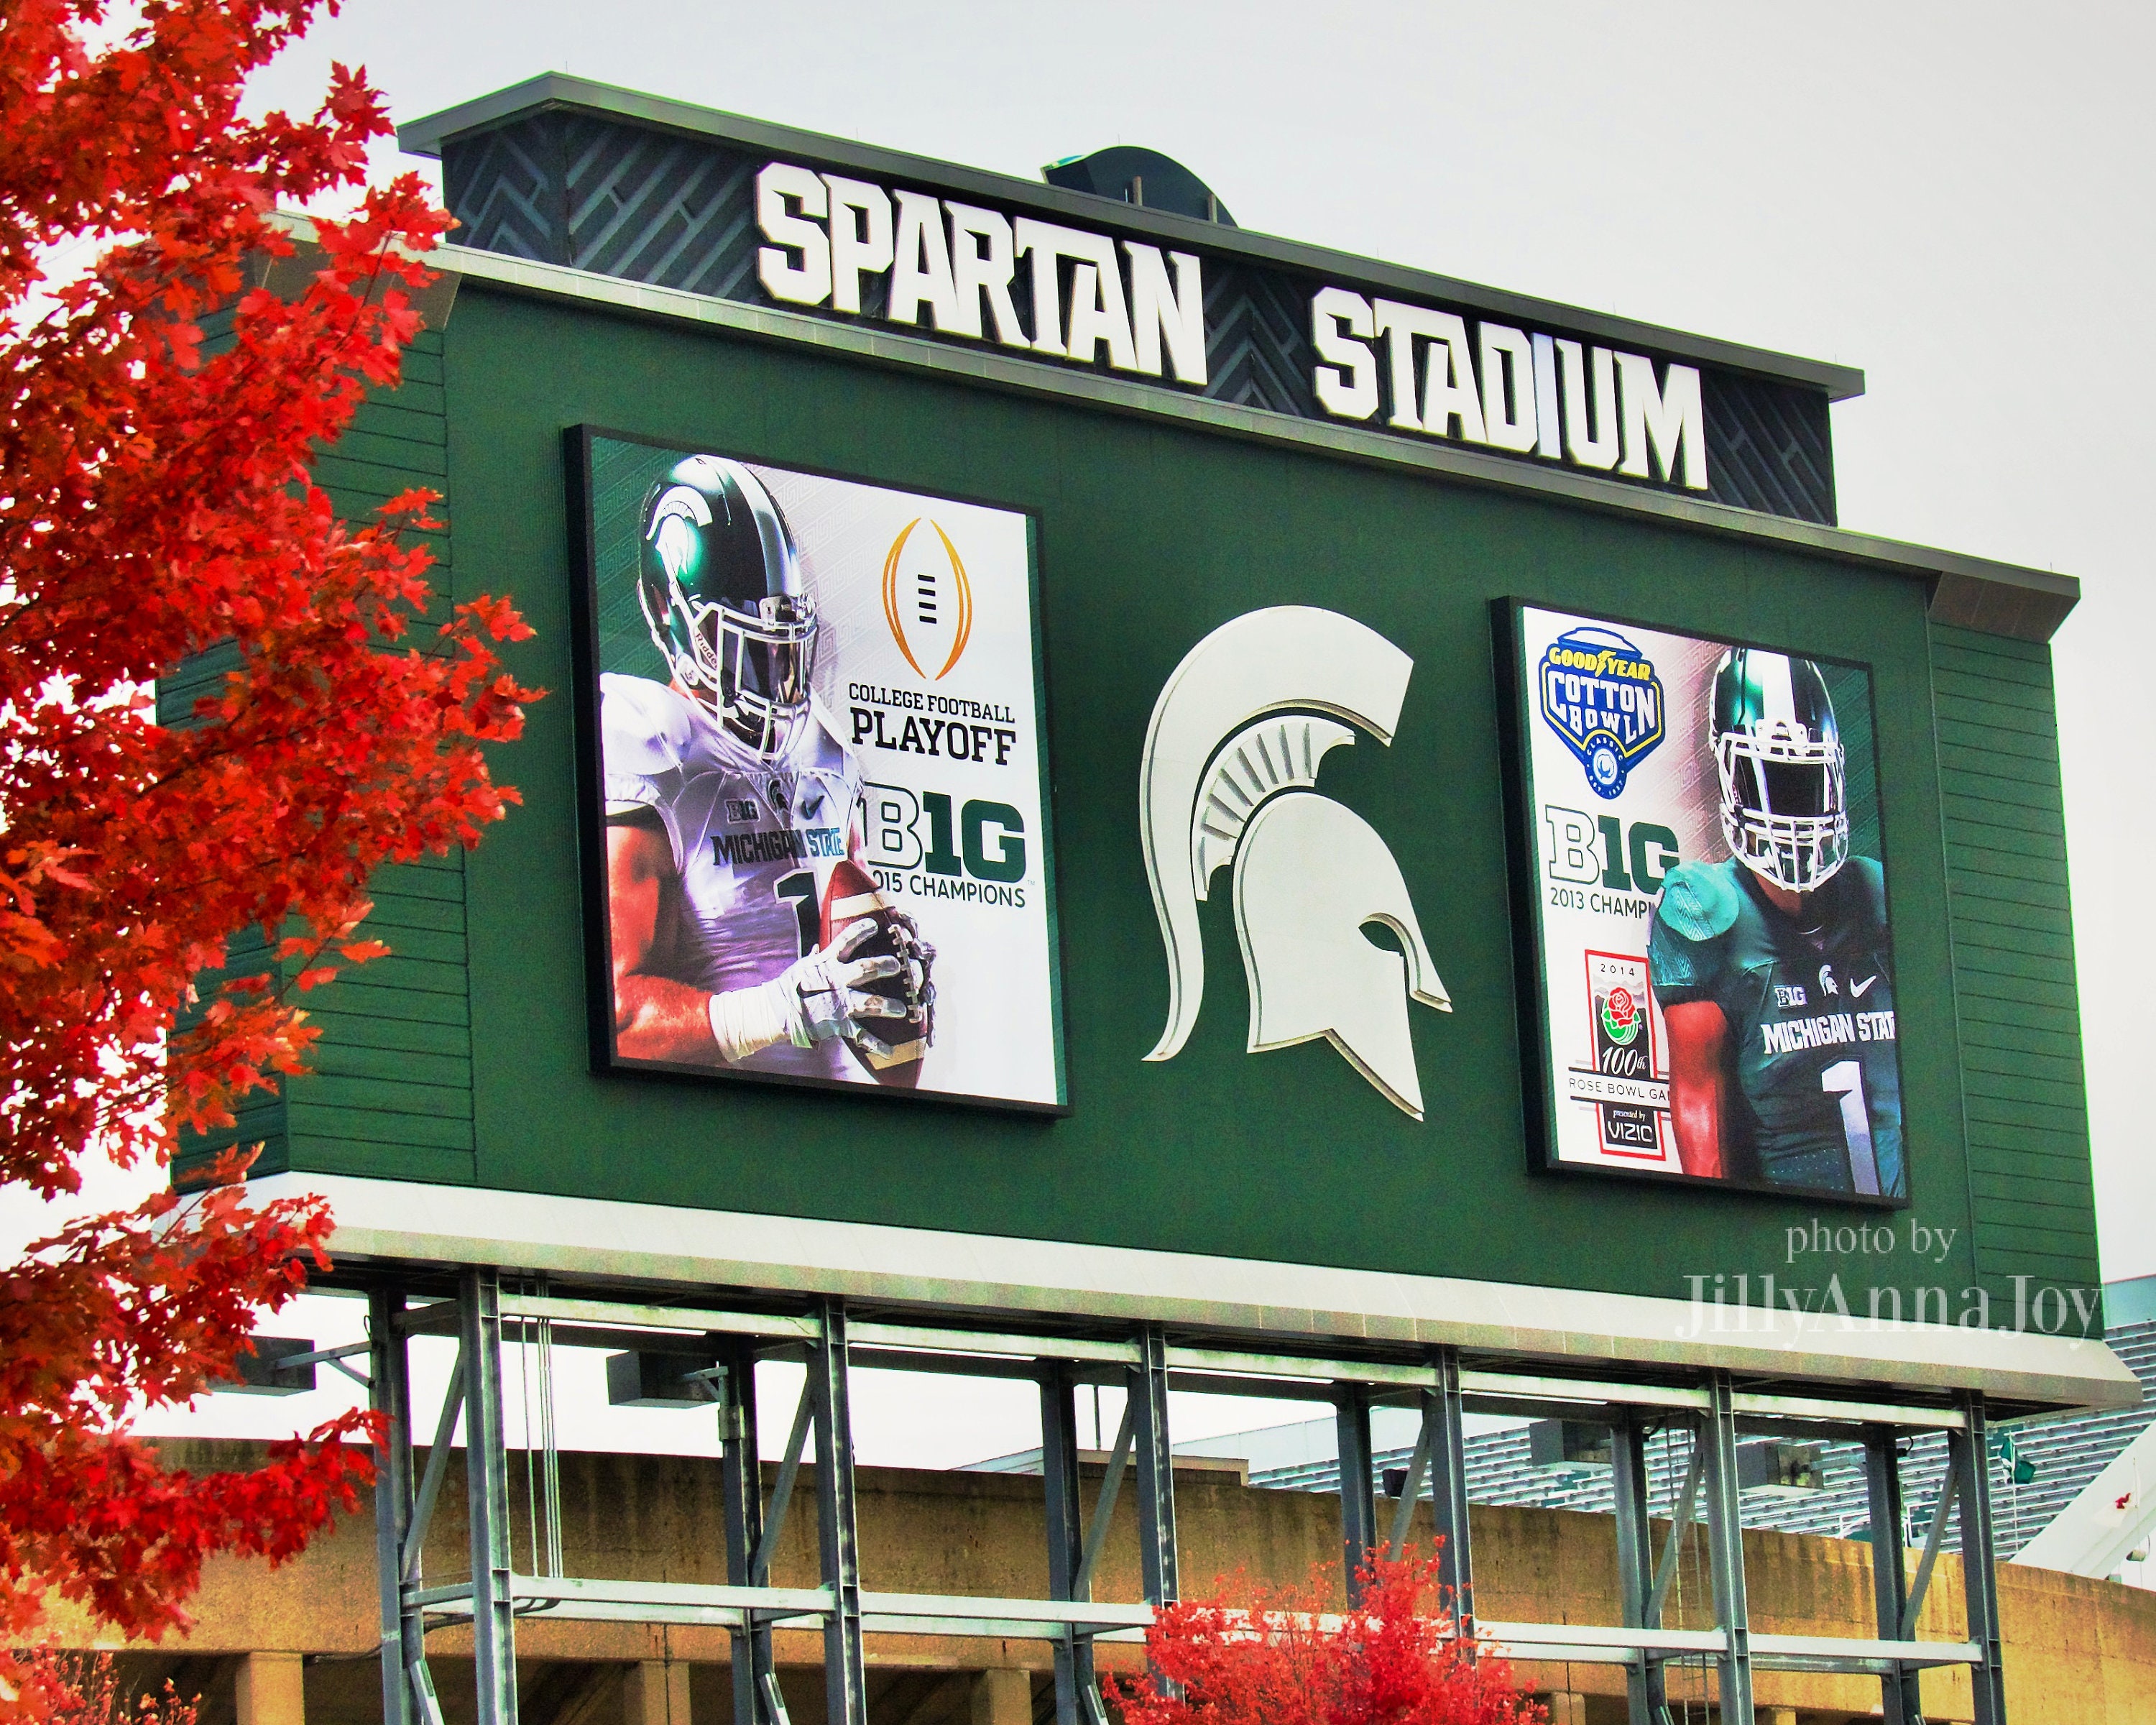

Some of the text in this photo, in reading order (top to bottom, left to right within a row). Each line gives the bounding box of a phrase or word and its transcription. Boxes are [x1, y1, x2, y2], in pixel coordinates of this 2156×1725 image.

[755, 162, 1708, 490] SPARTAN STADIUM
[696, 633, 717, 668] Ridde
[1549, 647, 1651, 681] GOODYEAR
[849, 683, 1015, 723] COLLEGE FOOTBALL
[1547, 671, 1655, 736] COTTON
[850, 707, 1016, 765] PLAYOFF
[1569, 704, 1638, 745] BOWL
[710, 827, 845, 865] MICHIGAN STATE
[872, 870, 1026, 908] 015 CHAMPIONS
[1550, 887, 1652, 919] 2013 CHAMPI
[774, 868, 821, 959] 1
[1600, 963, 1635, 976] 2014
[1761, 1011, 1896, 1054] MICHIGAN STAT
[1602, 1046, 1648, 1076] 100th
[1569, 1078, 1670, 1102] ROSE BOWL GA
[1608, 1121, 1653, 1142] VIZIO
[1822, 1060, 1881, 1195] 1
